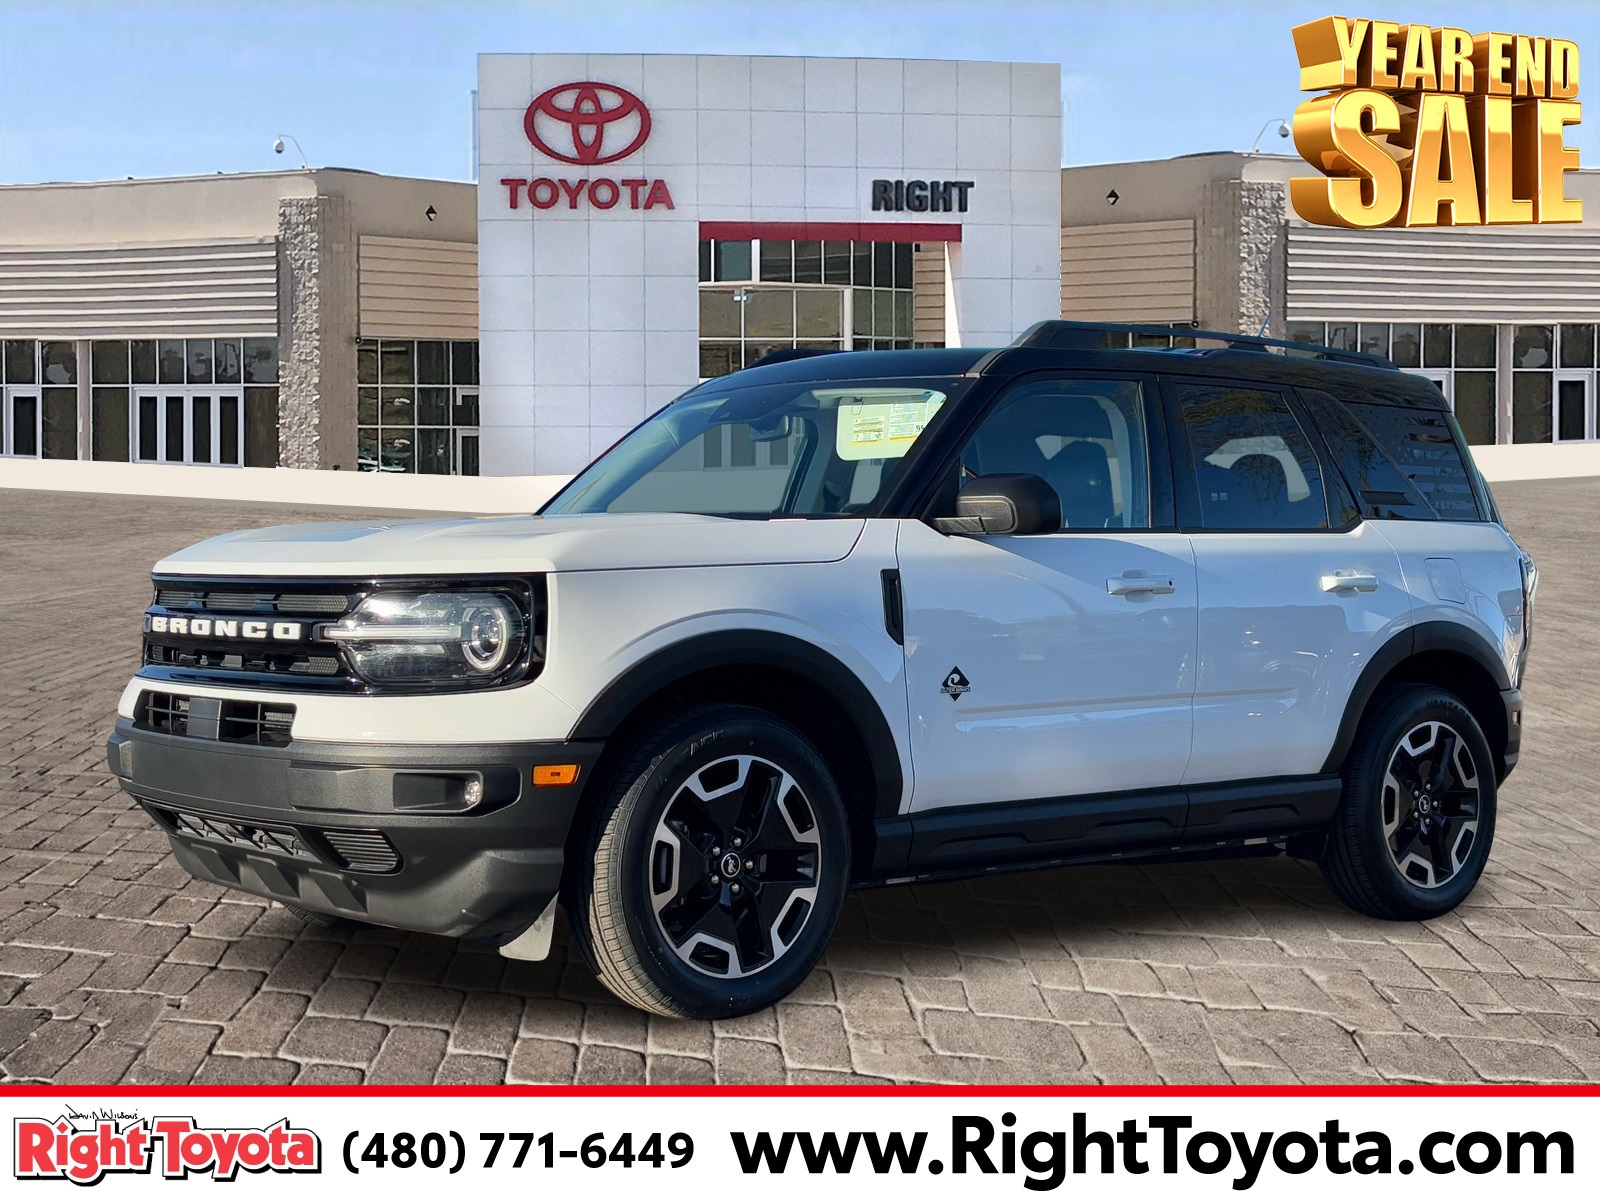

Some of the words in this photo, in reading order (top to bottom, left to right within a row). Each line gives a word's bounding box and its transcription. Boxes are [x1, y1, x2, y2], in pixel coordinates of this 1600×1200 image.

[501, 179, 674, 210] TOYOTA
[872, 180, 974, 212] RIGHT
[151, 616, 302, 640] BRONCO
